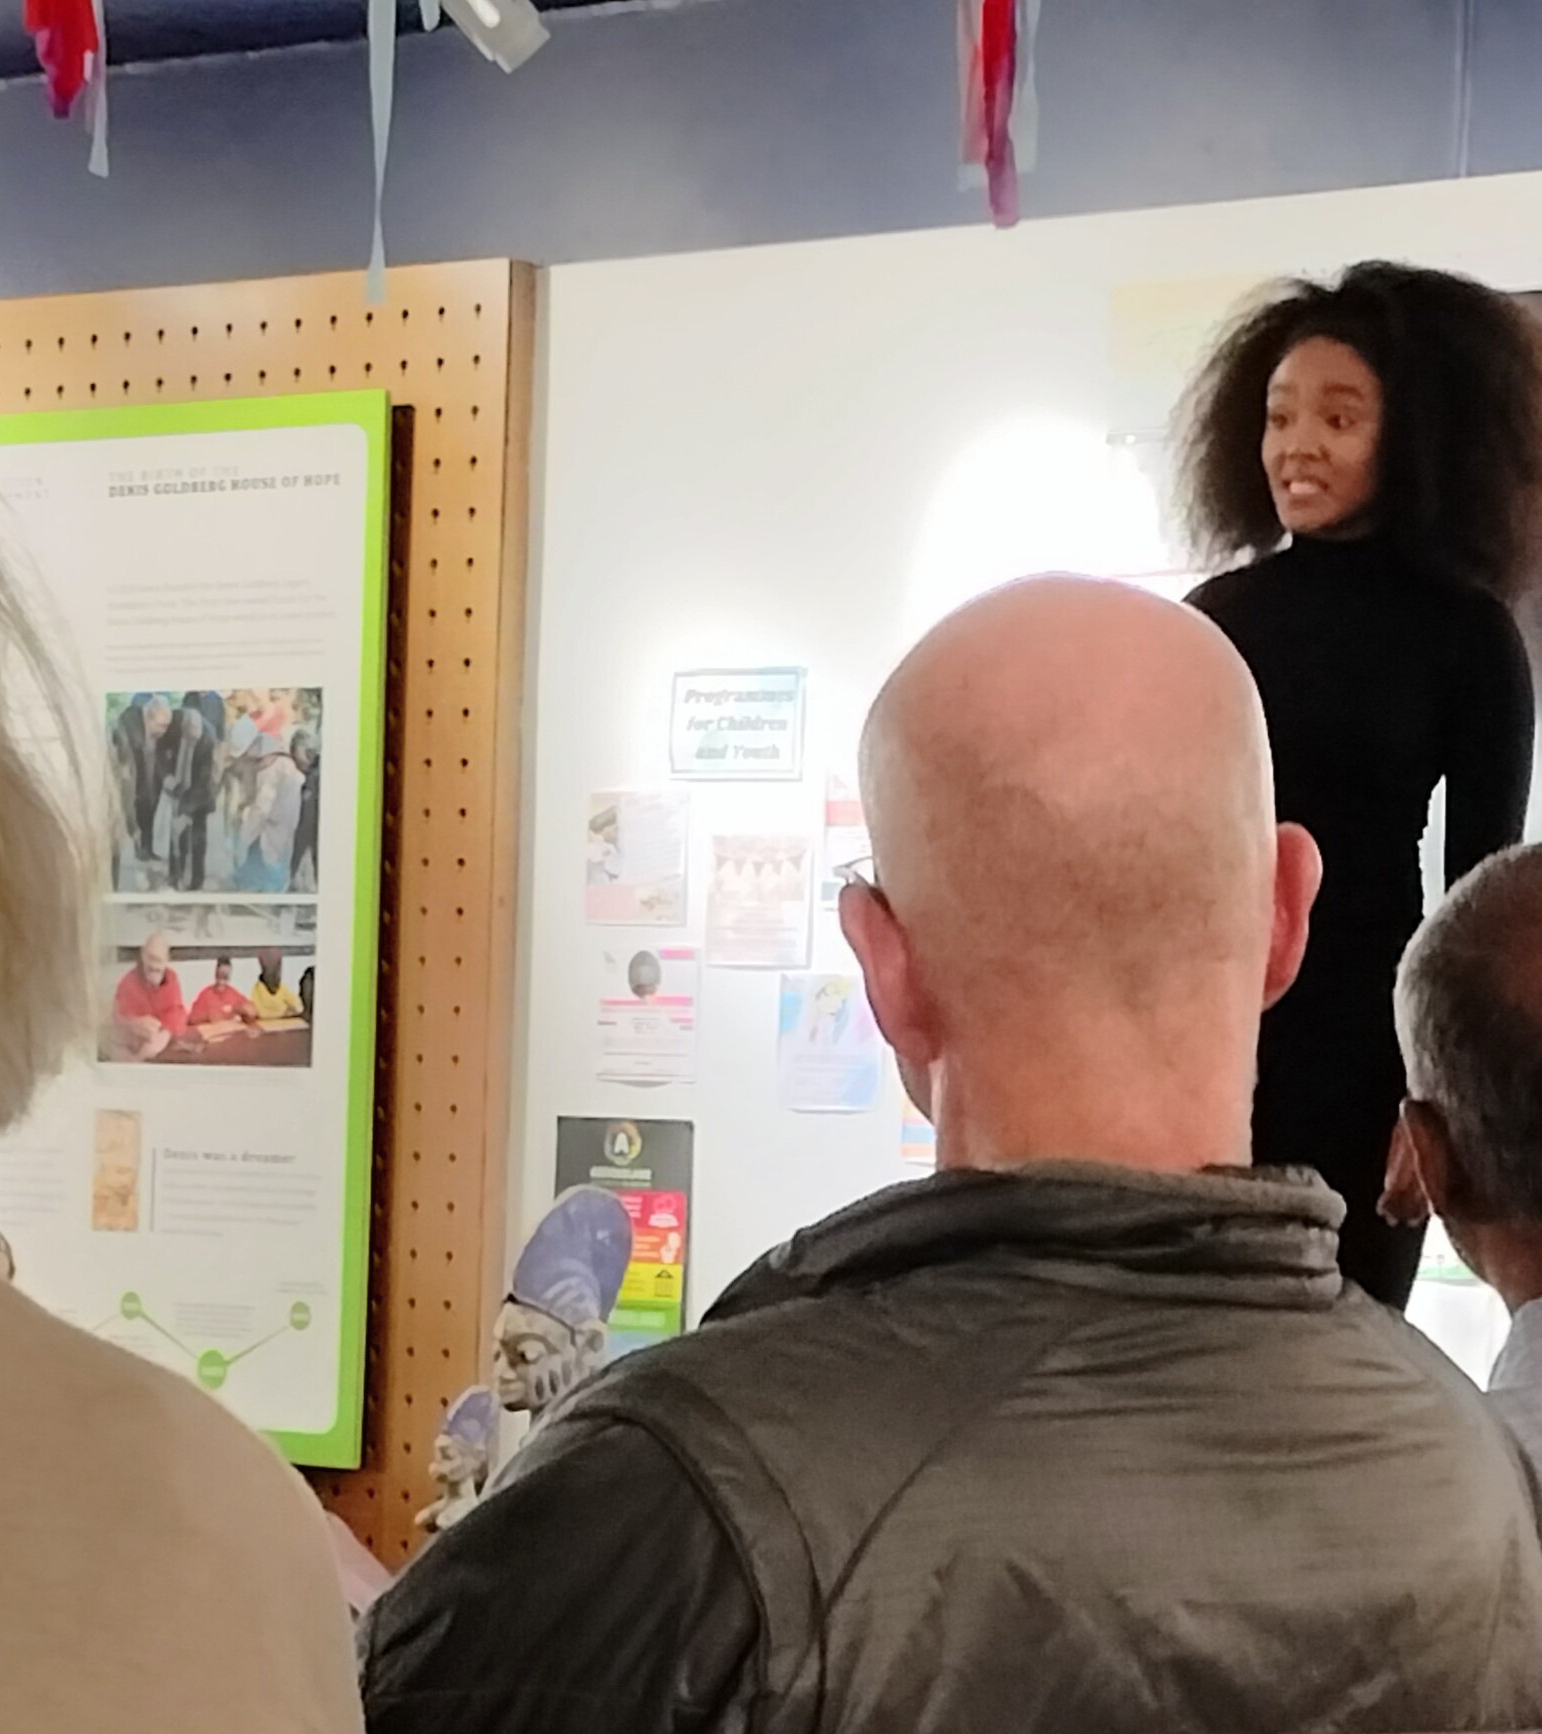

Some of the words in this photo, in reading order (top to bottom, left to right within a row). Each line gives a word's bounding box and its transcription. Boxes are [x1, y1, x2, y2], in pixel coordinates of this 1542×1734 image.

[108, 484, 149, 497] DENIS
[154, 480, 226, 495] GOLDBERG
[230, 477, 277, 491] HOUSE
[281, 475, 299, 487] OF
[303, 473, 341, 486] HOPE
[684, 689, 796, 706] Programmes
[686, 716, 715, 731] for
[716, 715, 788, 731] Children
[733, 743, 780, 759] Youth
[163, 1147, 198, 1161] Denis
[202, 1151, 227, 1162] was
[241, 1150, 296, 1164] dreamer
